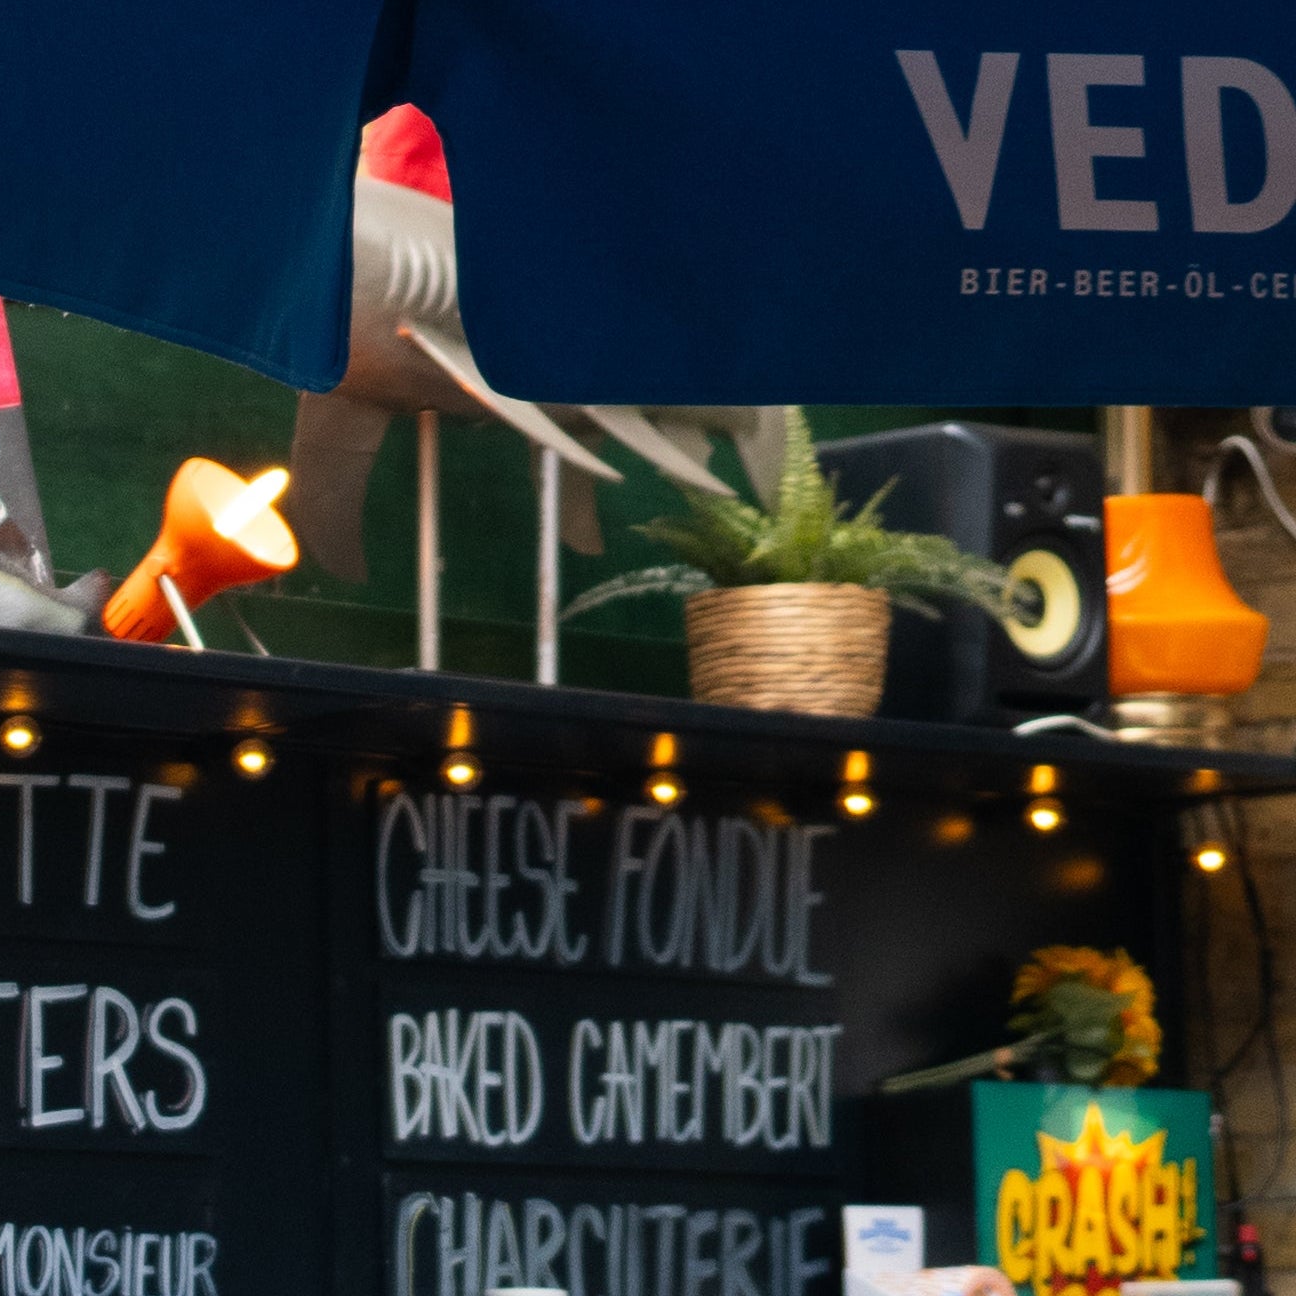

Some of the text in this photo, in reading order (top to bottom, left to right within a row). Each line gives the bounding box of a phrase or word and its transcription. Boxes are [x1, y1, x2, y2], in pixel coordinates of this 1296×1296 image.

[894, 50, 1296, 233] VED
[377, 793, 840, 986] CHEESE FONDUE
[388, 1009, 844, 1152] BAKED CAMEMBERT
